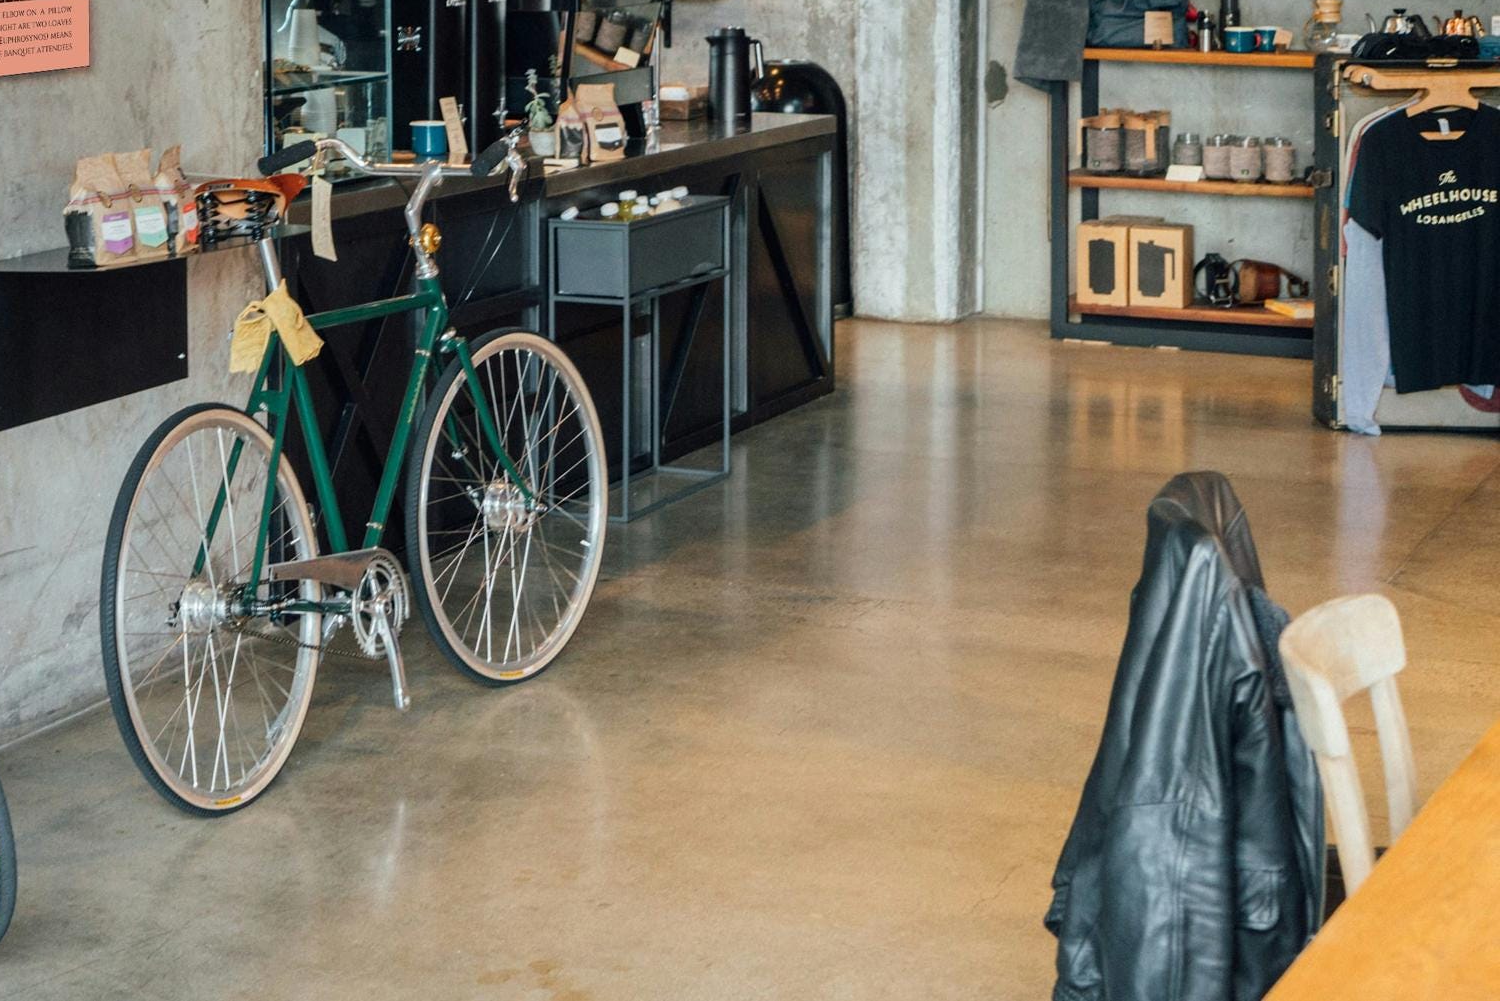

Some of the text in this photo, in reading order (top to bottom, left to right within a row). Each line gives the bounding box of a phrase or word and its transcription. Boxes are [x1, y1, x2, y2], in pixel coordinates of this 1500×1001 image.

[1, 9, 25, 19] ELBOW
[25, 8, 36, 17] ON
[47, 6, 72, 15] PILLOW
[17, 22, 30, 30] ARE
[47, 18, 72, 27] LOAVES
[50, 31, 72, 39] MEANS
[3, 46, 34, 58] BANQUET
[36, 42, 72, 54] ATTENDEES
[1438, 169, 1458, 187] The
[1400, 188, 1498, 216] WHEELHOUSE
